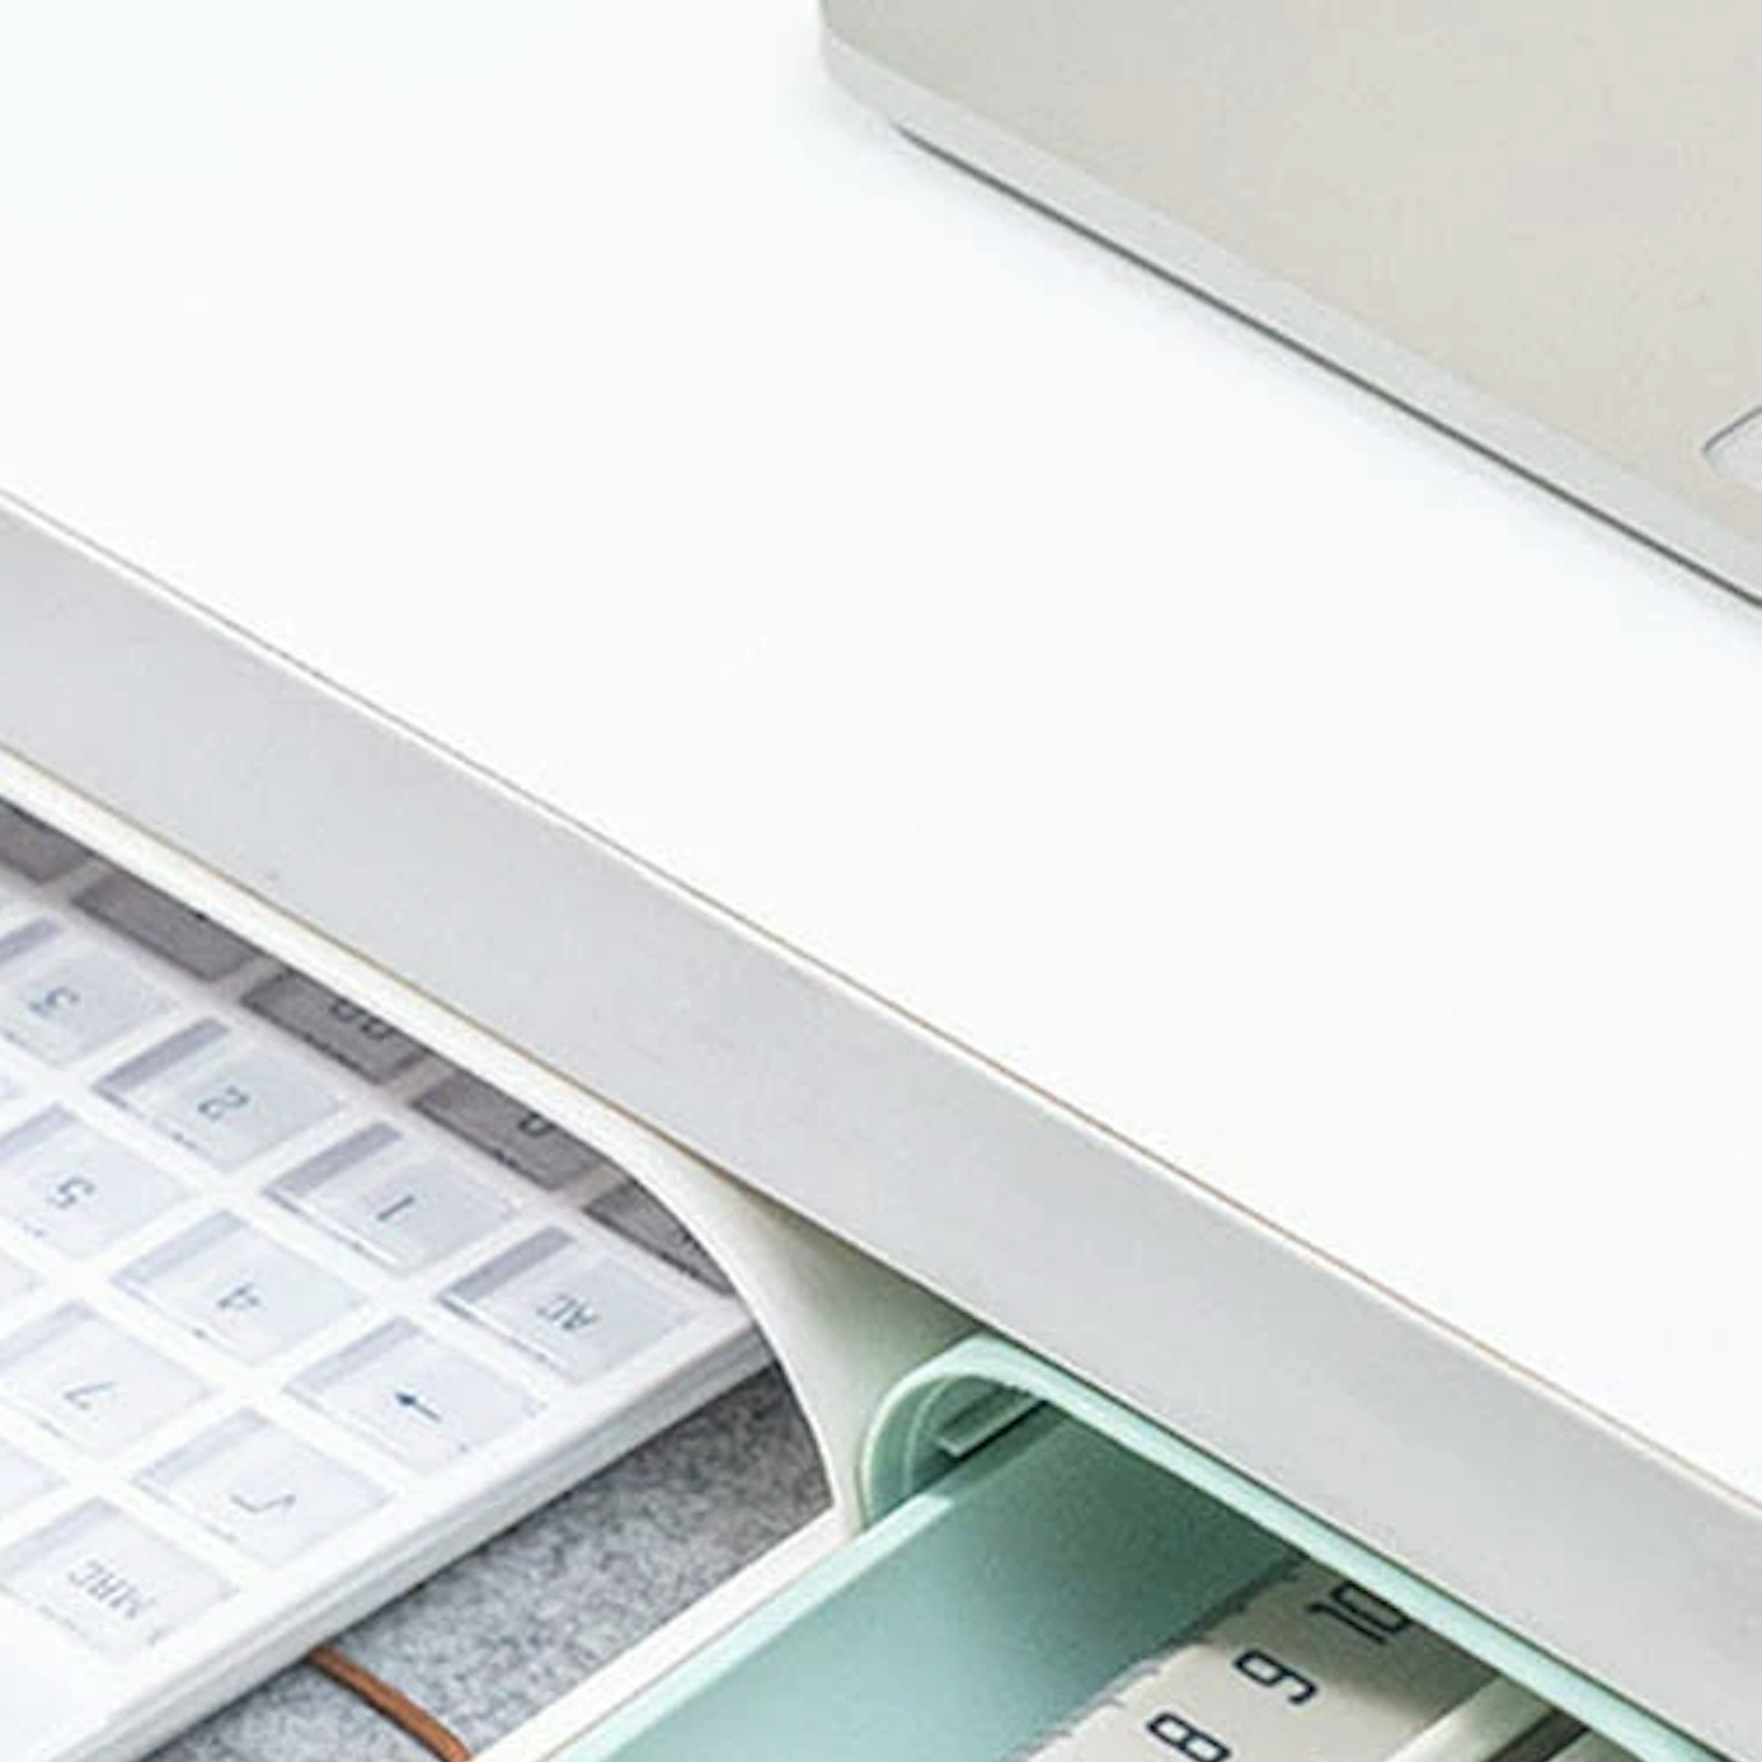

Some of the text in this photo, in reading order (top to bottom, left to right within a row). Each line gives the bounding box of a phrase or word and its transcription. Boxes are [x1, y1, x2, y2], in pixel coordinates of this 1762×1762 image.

[196, 1086, 250, 1120] 2
[52, 1176, 97, 1210] 5
[215, 1284, 261, 1312] 4
[538, 1292, 599, 1332] AC
[67, 1558, 158, 1620] MRC
[1231, 1647, 1318, 1706] 9
[1305, 1578, 1411, 1646] 10
